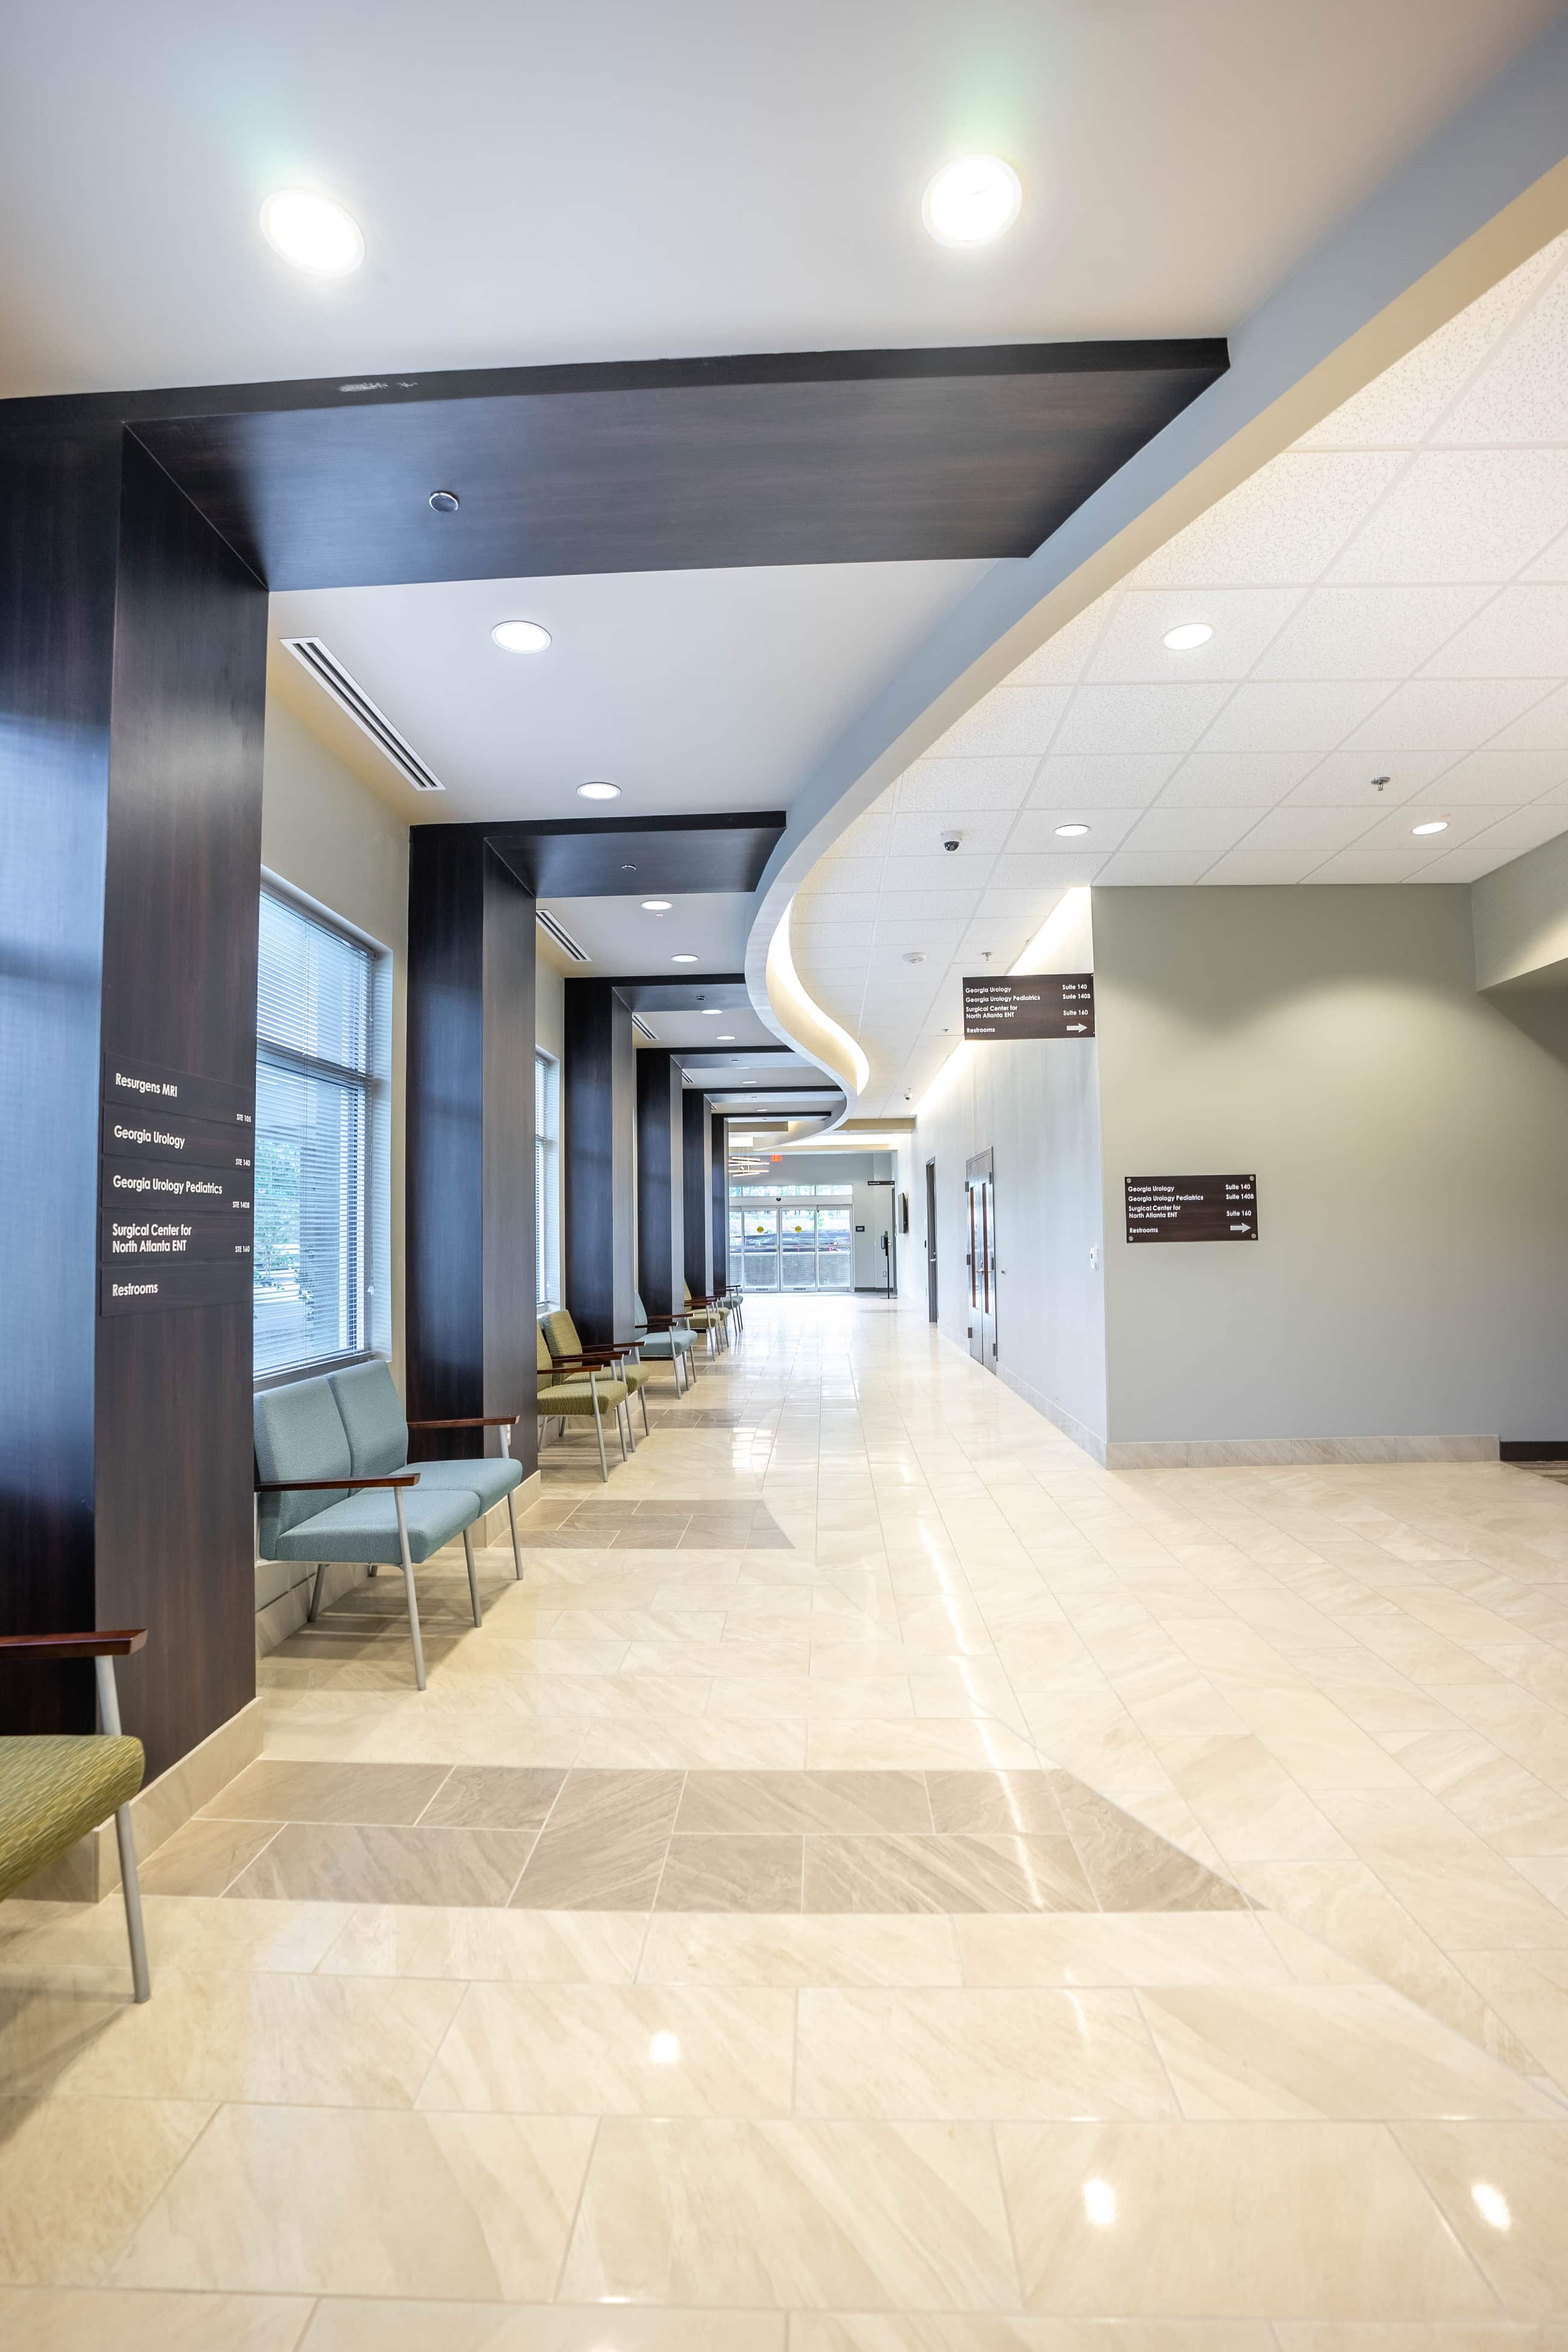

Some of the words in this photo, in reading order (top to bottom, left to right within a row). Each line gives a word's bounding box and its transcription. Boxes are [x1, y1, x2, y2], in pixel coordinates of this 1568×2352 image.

[115, 1073, 160, 1094] Resurgens
[162, 1084, 178, 1098] MRI
[114, 1125, 151, 1144] Georgia
[153, 1131, 185, 1149] Urology
[113, 1175, 151, 1190] Georgia
[153, 1178, 184, 1194] Urology
[186, 1181, 223, 1195] Pediatrics
[112, 1224, 149, 1239] Surgical
[151, 1224, 179, 1236] Center
[181, 1223, 192, 1236] for
[112, 1240, 137, 1253] North
[139, 1240, 170, 1253] Atlanta
[172, 1240, 187, 1251] ENT
[112, 1282, 158, 1297] Restrooms
